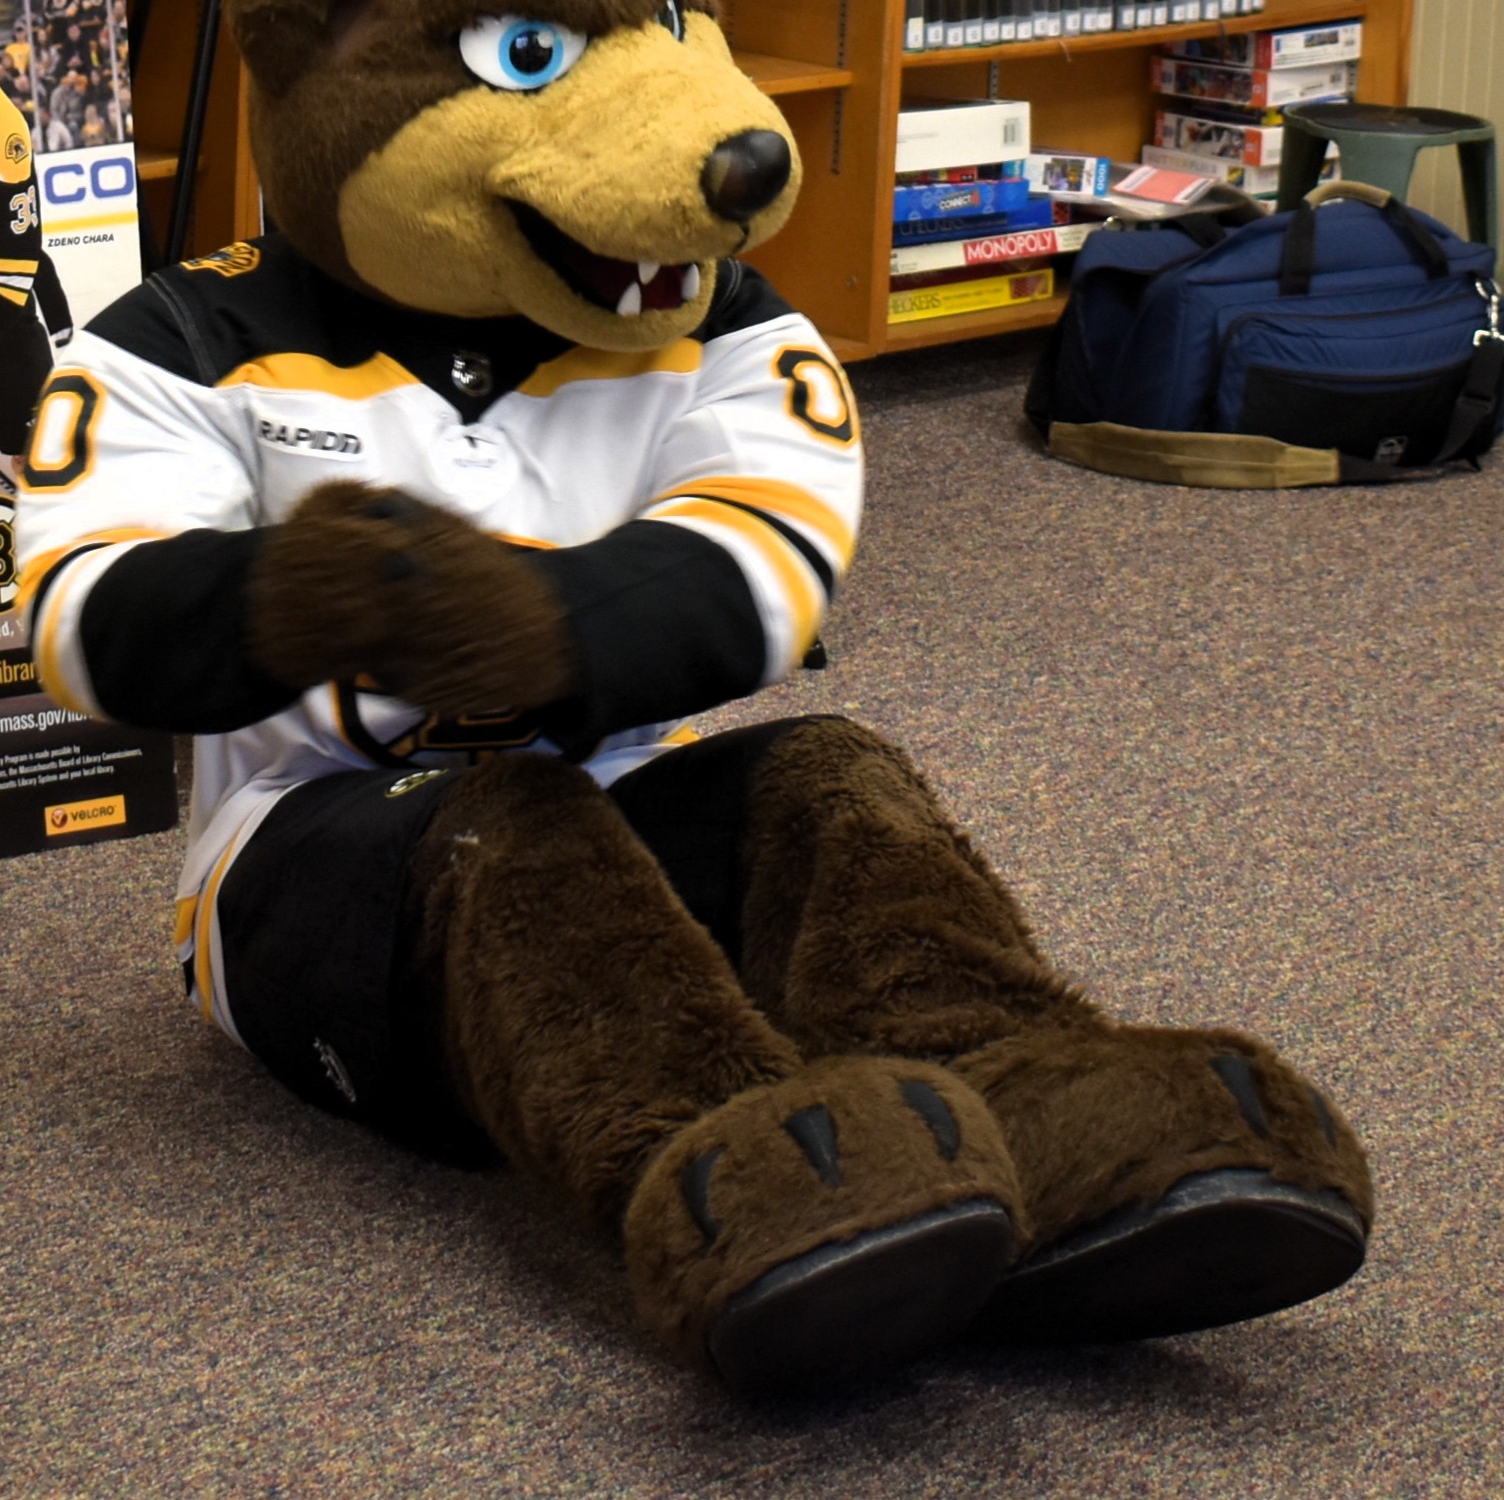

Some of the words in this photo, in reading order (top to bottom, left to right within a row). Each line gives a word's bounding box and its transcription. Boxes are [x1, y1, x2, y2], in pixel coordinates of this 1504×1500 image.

[44, 157, 135, 204] CO
[939, 196, 971, 210] CONNECT
[48, 235, 80, 248] ZDENO
[83, 233, 114, 245] CHARA
[967, 232, 1056, 261] MONOPOLY
[772, 343, 857, 446] 0
[17, 368, 108, 493] 0
